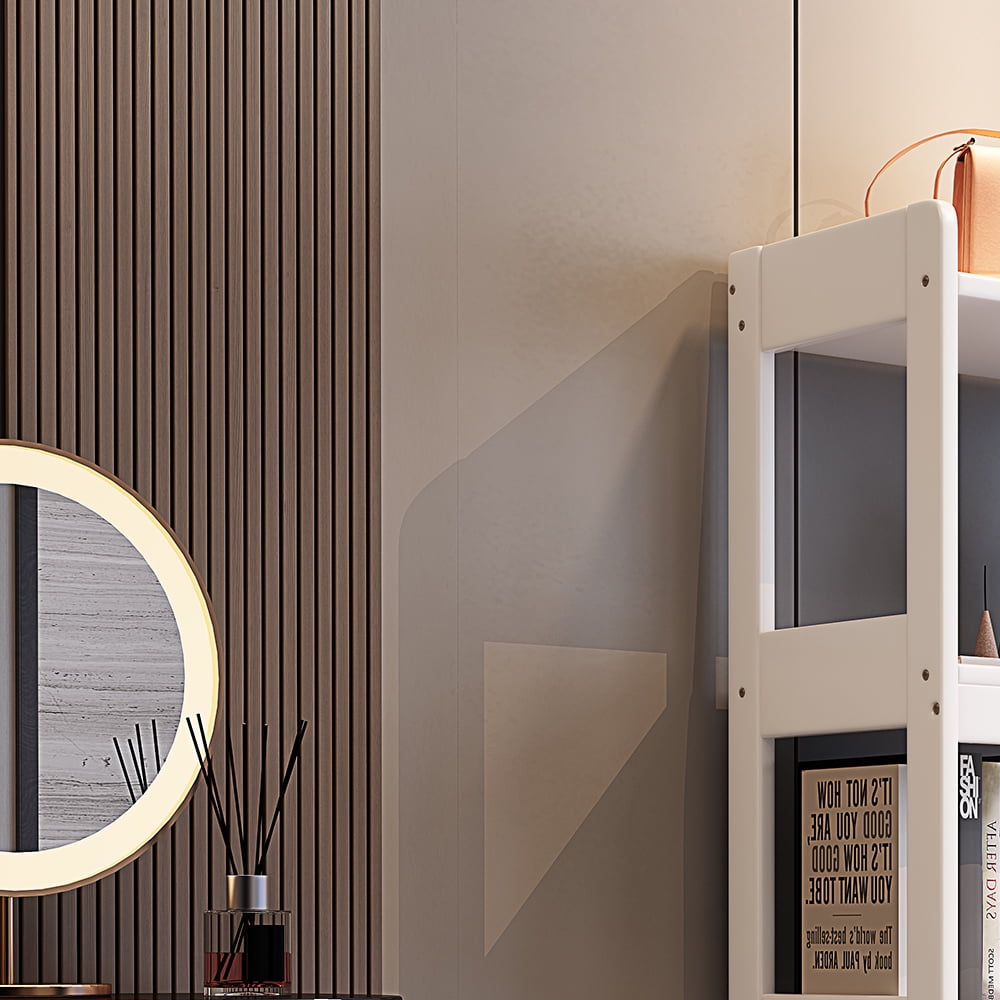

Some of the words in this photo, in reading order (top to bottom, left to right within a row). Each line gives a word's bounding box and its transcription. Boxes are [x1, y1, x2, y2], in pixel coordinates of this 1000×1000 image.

[960, 754, 976, 777] FA
[959, 775, 979, 798] SHI
[959, 797, 978, 819] ON
